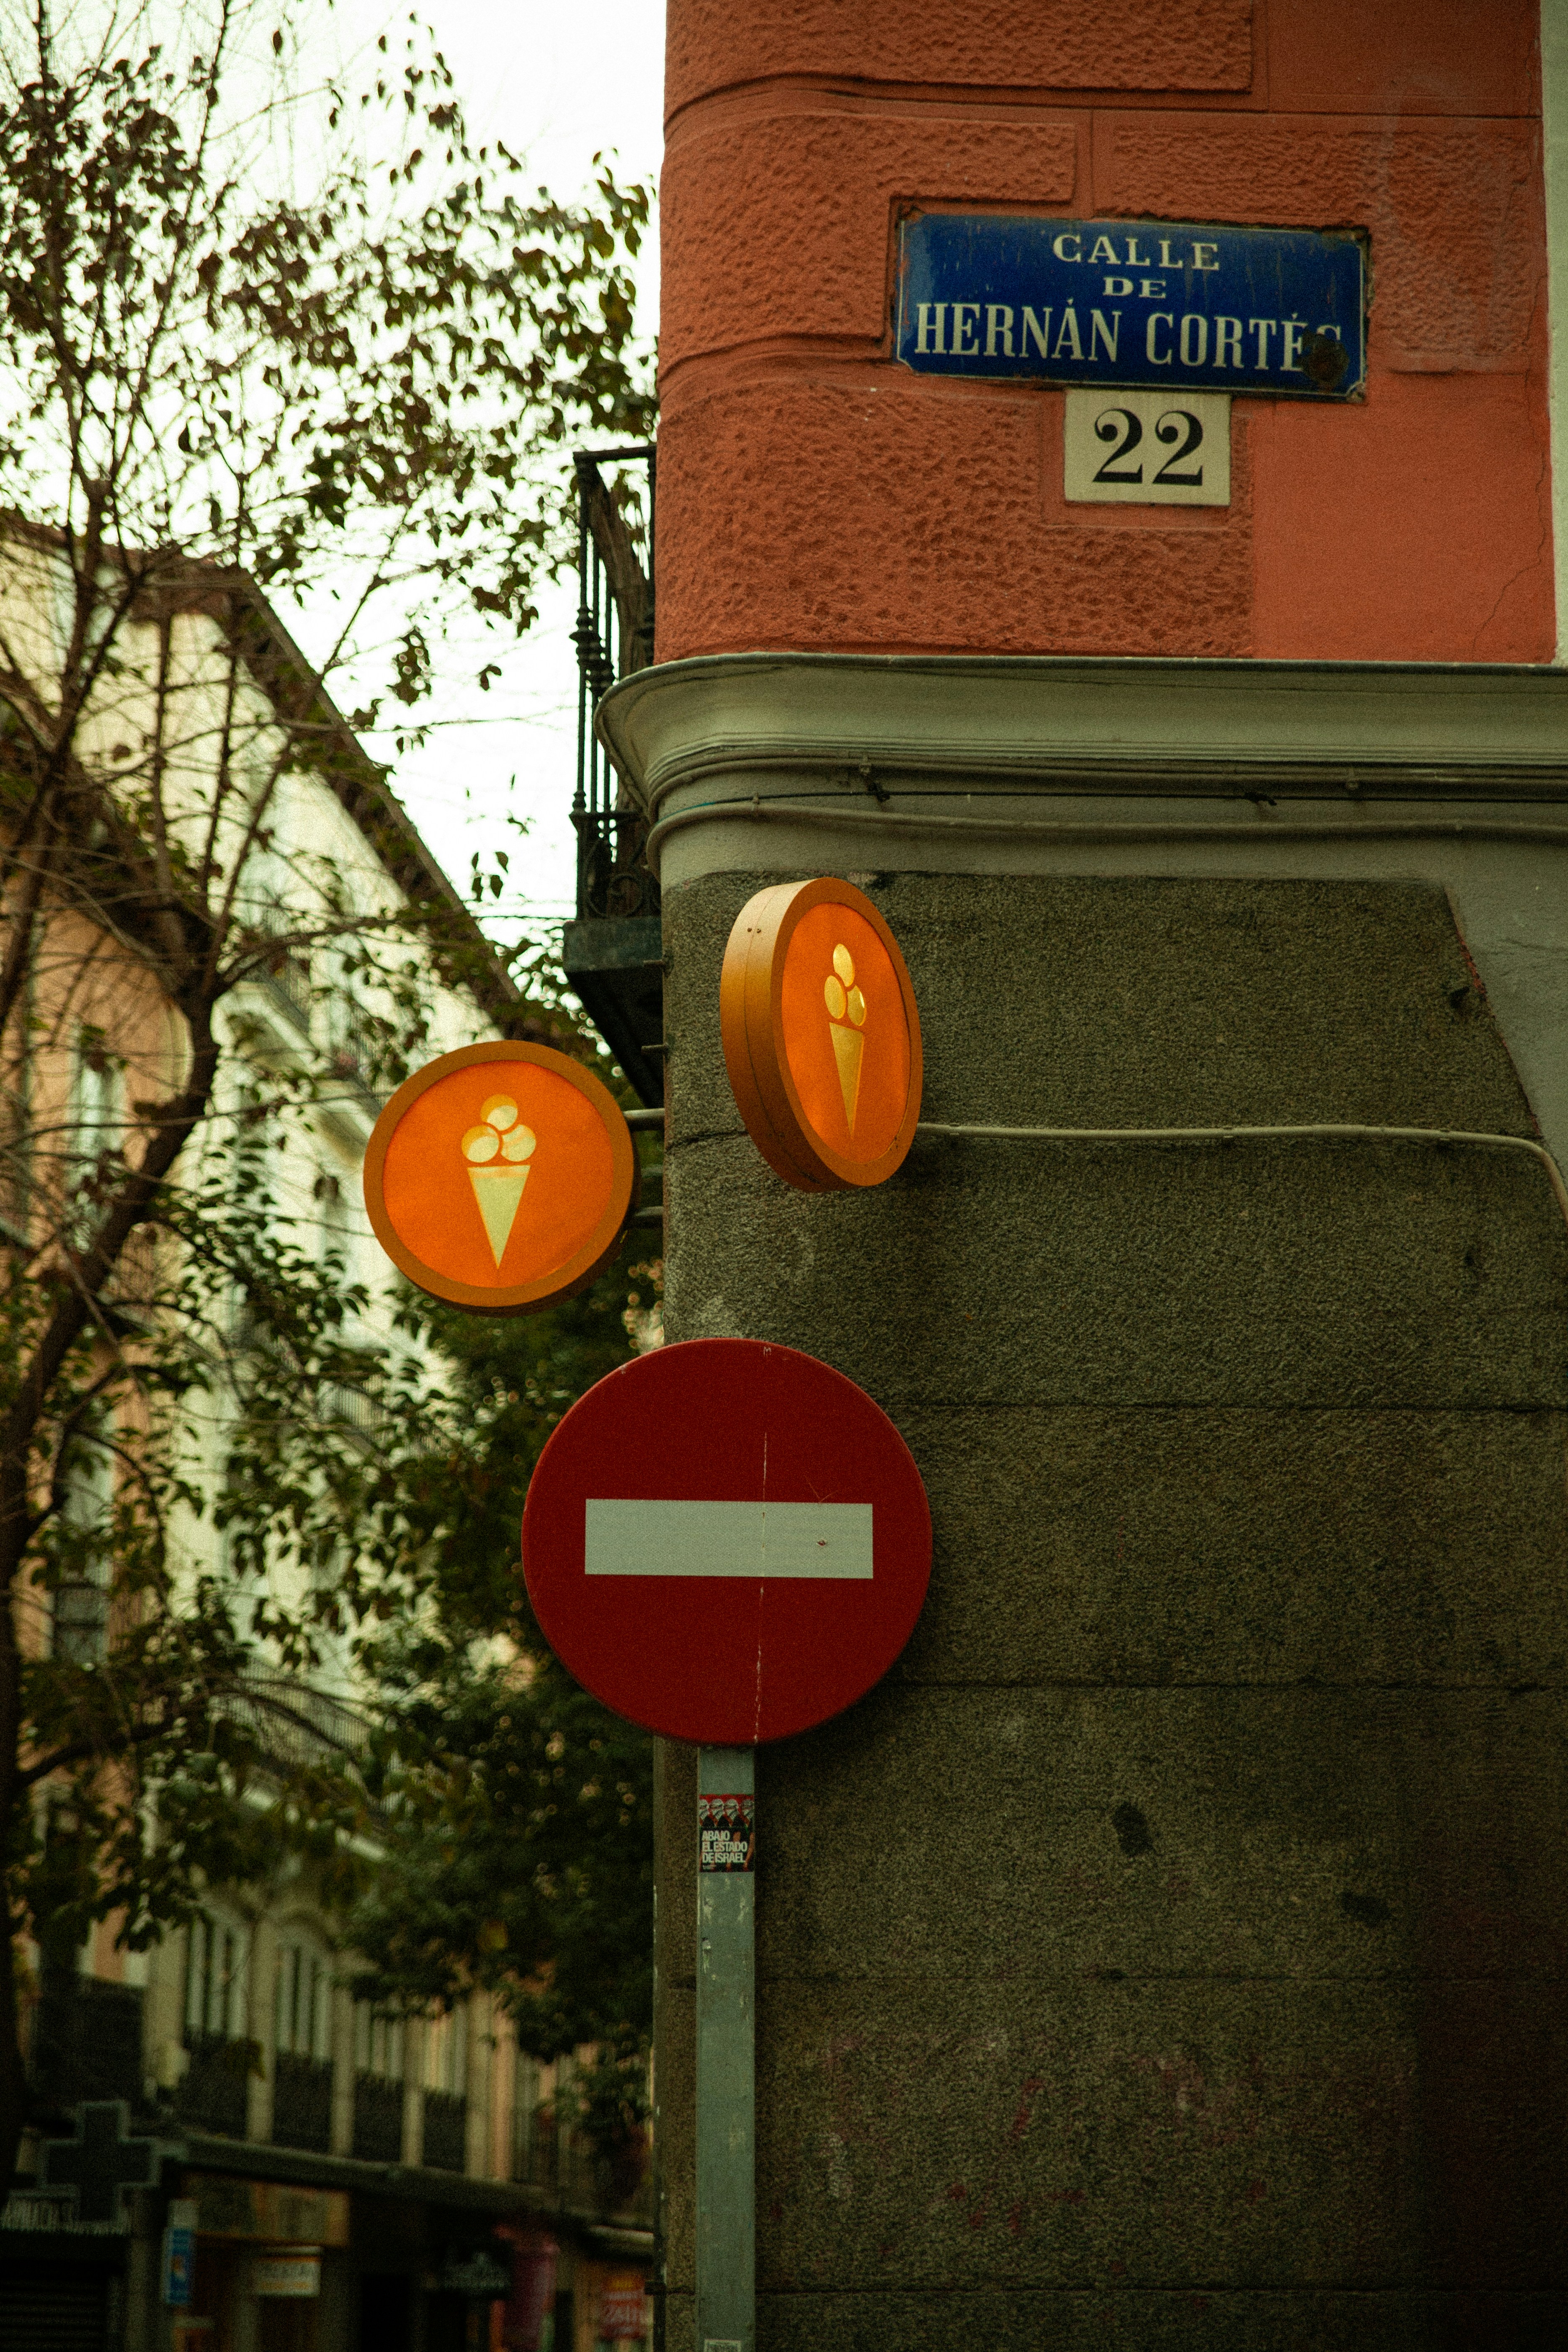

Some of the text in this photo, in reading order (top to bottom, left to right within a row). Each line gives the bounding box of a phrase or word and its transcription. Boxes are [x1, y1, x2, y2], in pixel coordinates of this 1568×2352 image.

[1052, 234, 1220, 271] CALLE
[1102, 276, 1167, 299] DE
[914, 298, 1122, 363] HERNÁN
[1092, 407, 1204, 486] 22
[702, 1830, 730, 1841] ABAJO
[702, 1841, 748, 1852] EL ESTADO
[702, 1852, 746, 1863] DE ISRAEL
